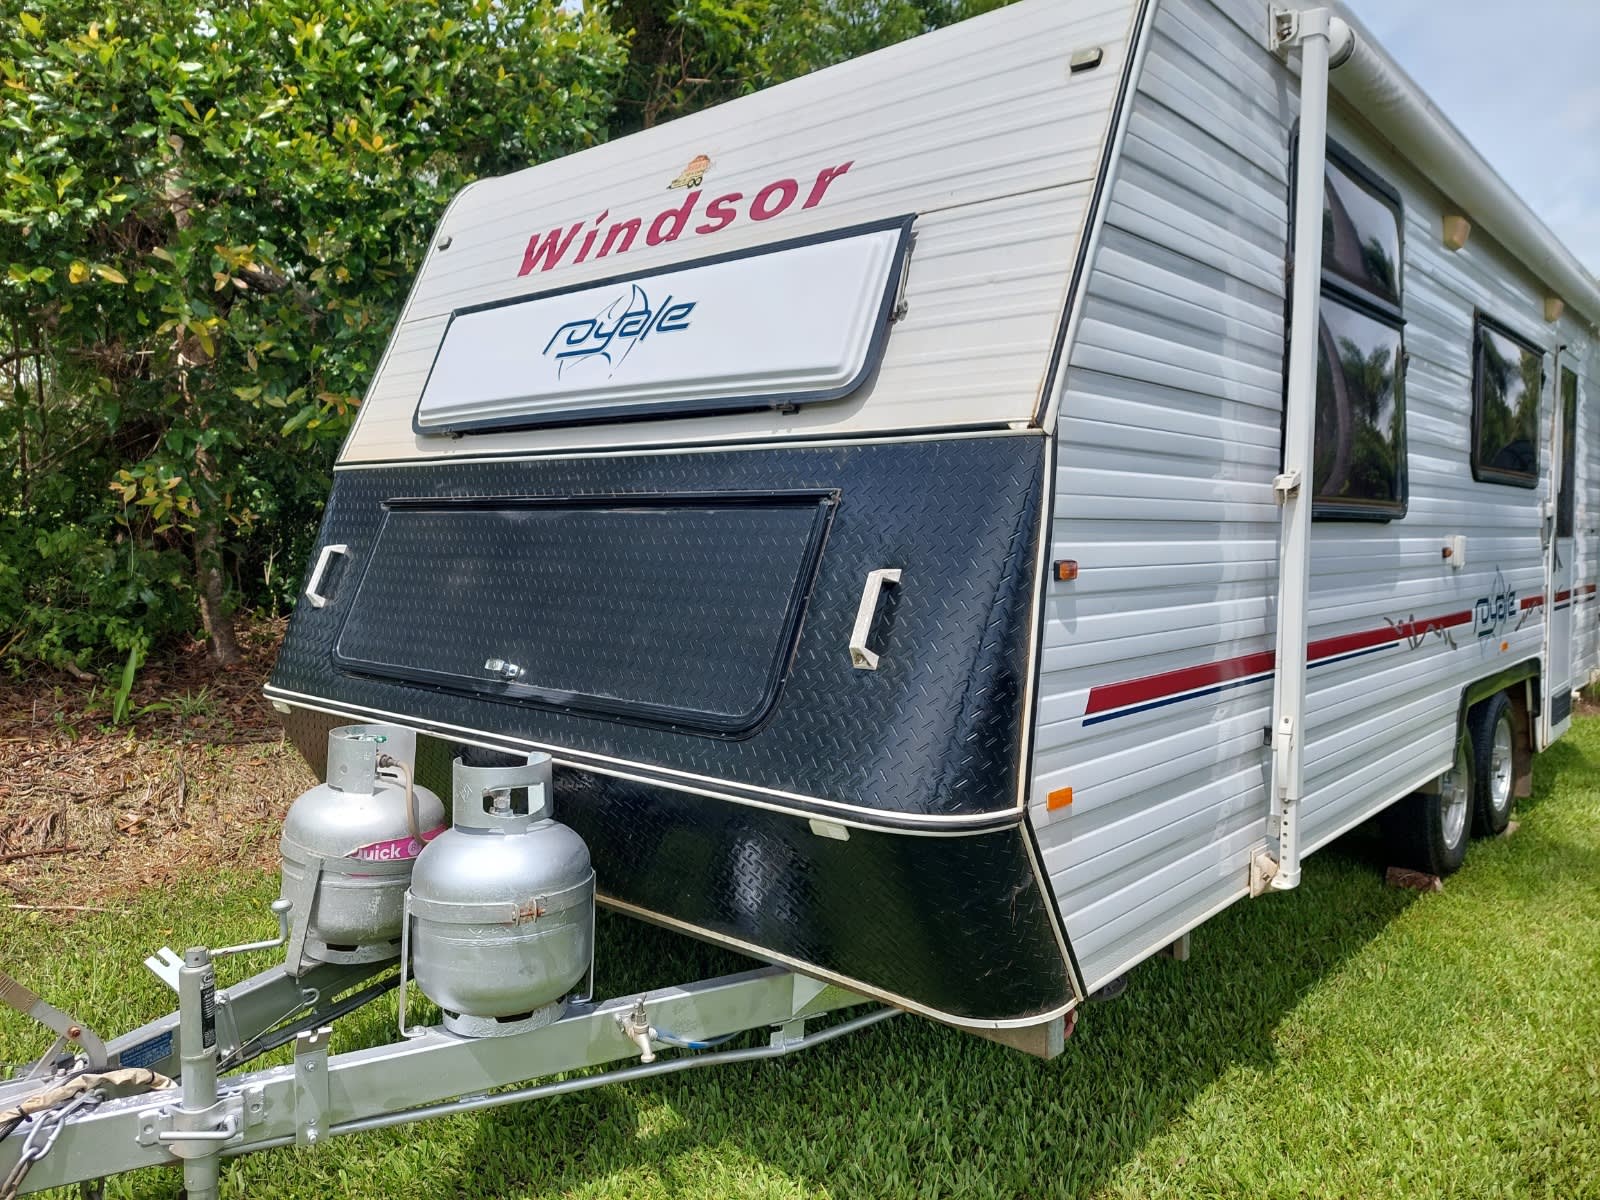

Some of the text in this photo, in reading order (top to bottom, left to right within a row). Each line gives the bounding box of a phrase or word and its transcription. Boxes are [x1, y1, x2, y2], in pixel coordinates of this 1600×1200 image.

[517, 160, 855, 277] Windsor
[542, 289, 697, 360] royale
[1473, 584, 1516, 638] royale
